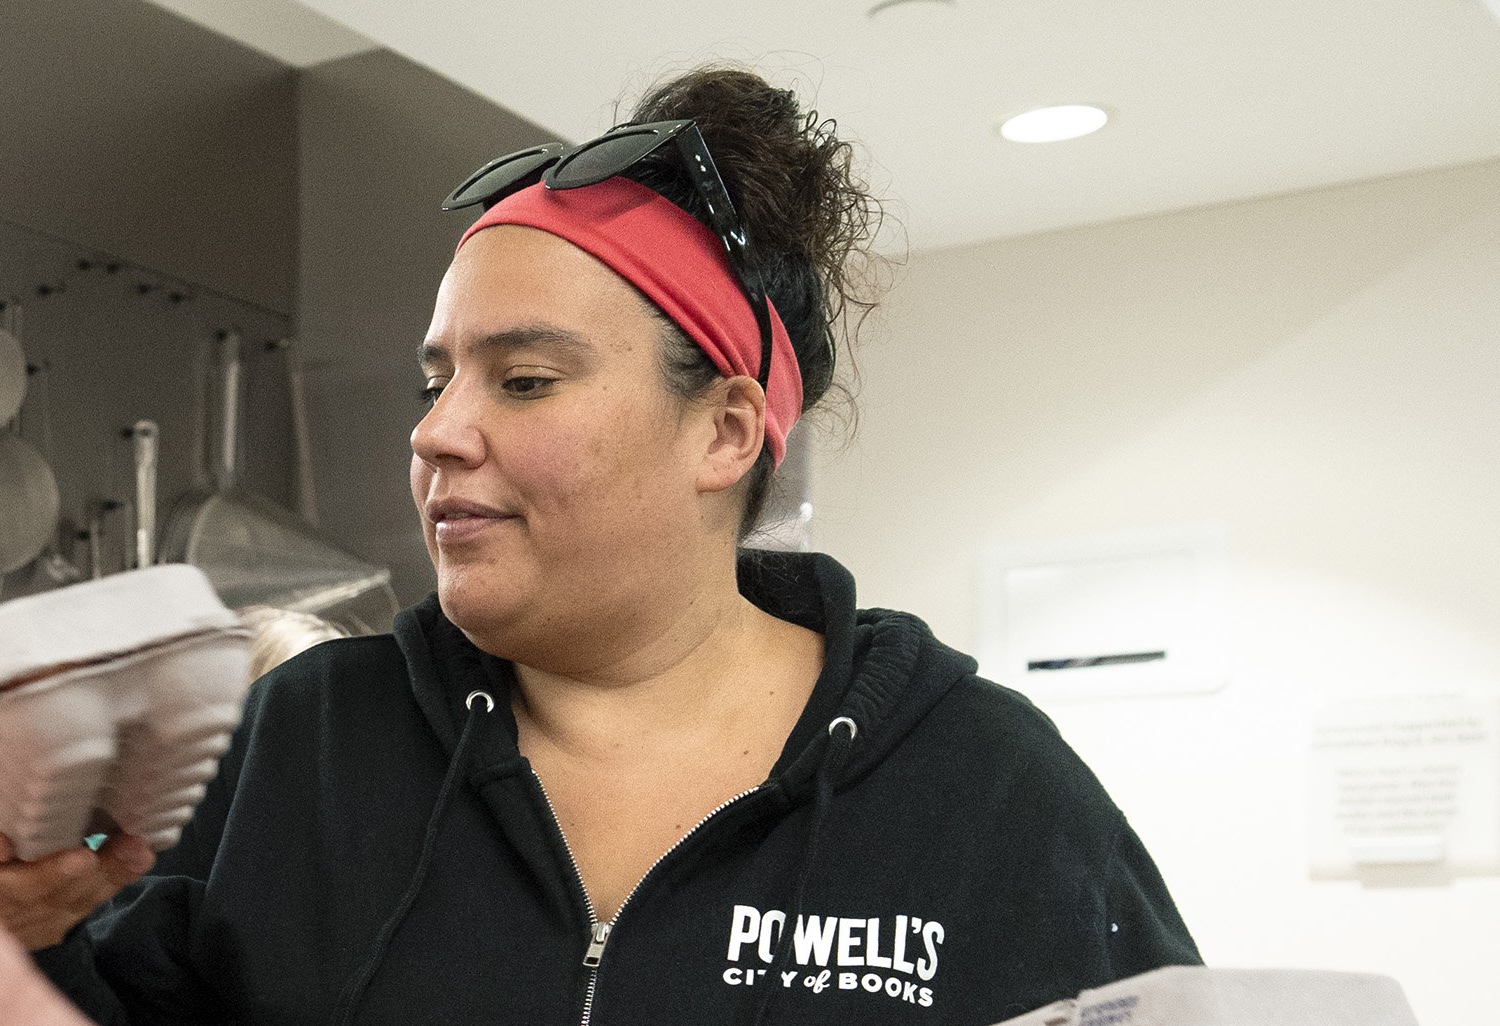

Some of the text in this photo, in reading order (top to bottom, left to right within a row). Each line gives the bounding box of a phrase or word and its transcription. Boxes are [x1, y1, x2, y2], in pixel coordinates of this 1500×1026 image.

[726, 904, 945, 981] POWELL'S
[722, 968, 935, 1008] CIY of BOOKS
